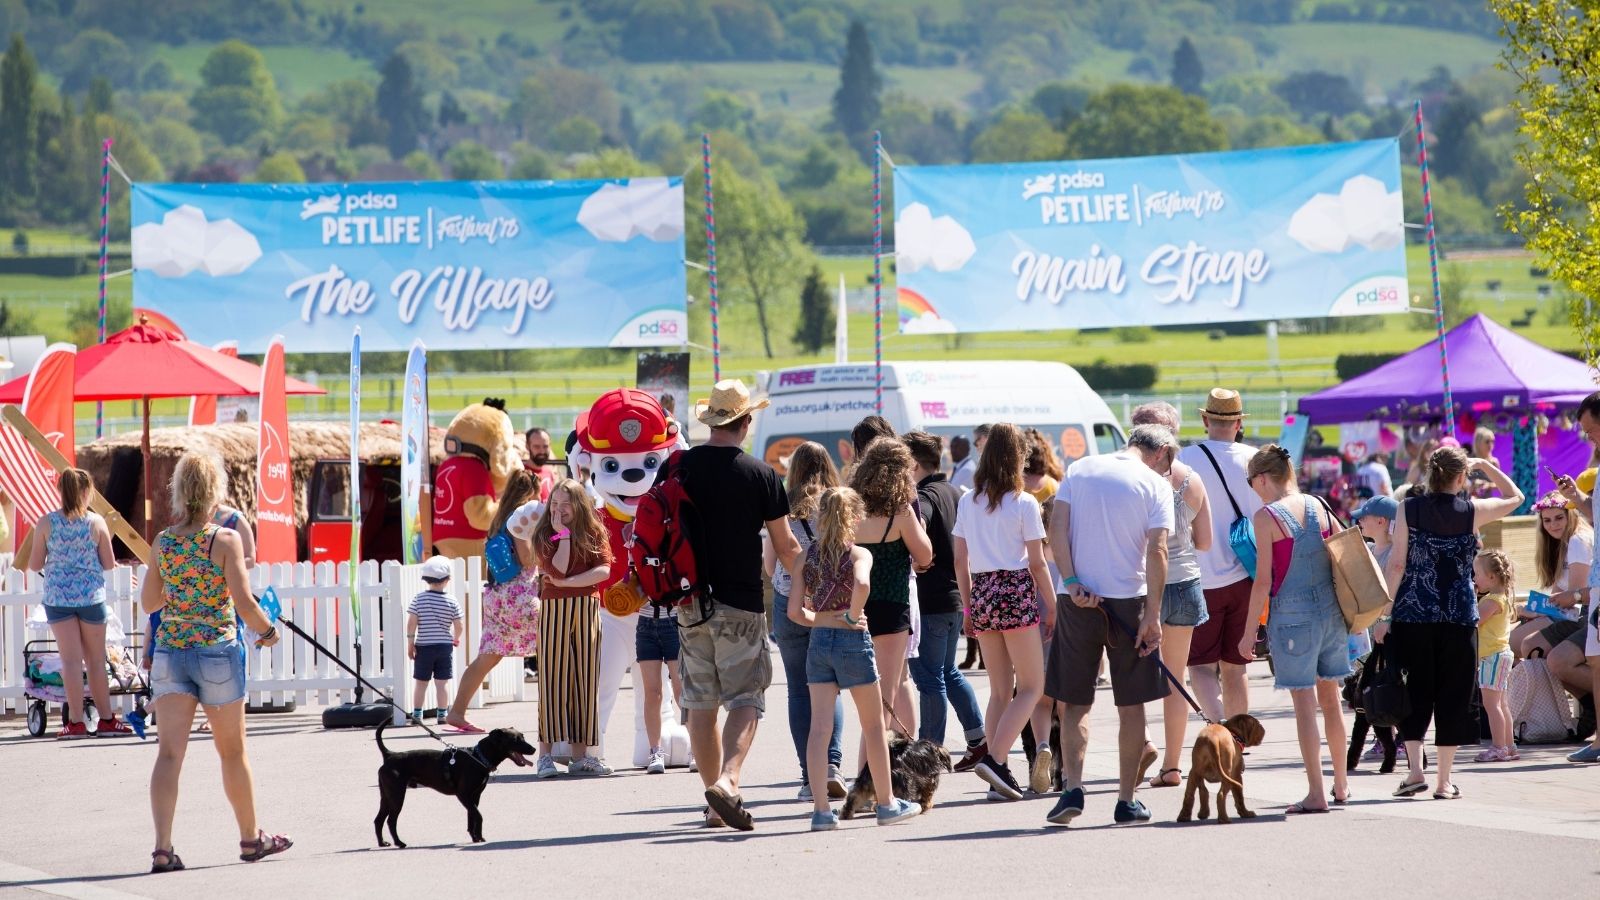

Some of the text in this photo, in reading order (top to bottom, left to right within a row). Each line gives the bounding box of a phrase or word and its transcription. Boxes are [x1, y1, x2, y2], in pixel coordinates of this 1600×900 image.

[1059, 170, 1105, 193] pdsa
[345, 191, 397, 214] pdsa
[1040, 193, 1131, 225] PETLIFE
[321, 215, 421, 245] PETLIFE
[1011, 239, 1270, 308] Main Stage
[284, 263, 554, 335] The Village
[1356, 287, 1399, 306] pdsa
[639, 319, 678, 338] pdsa
[779, 369, 816, 387] FREE
[775, 400, 881, 416] pdsa.org.uk/petchec
[920, 401, 949, 419] FREE
